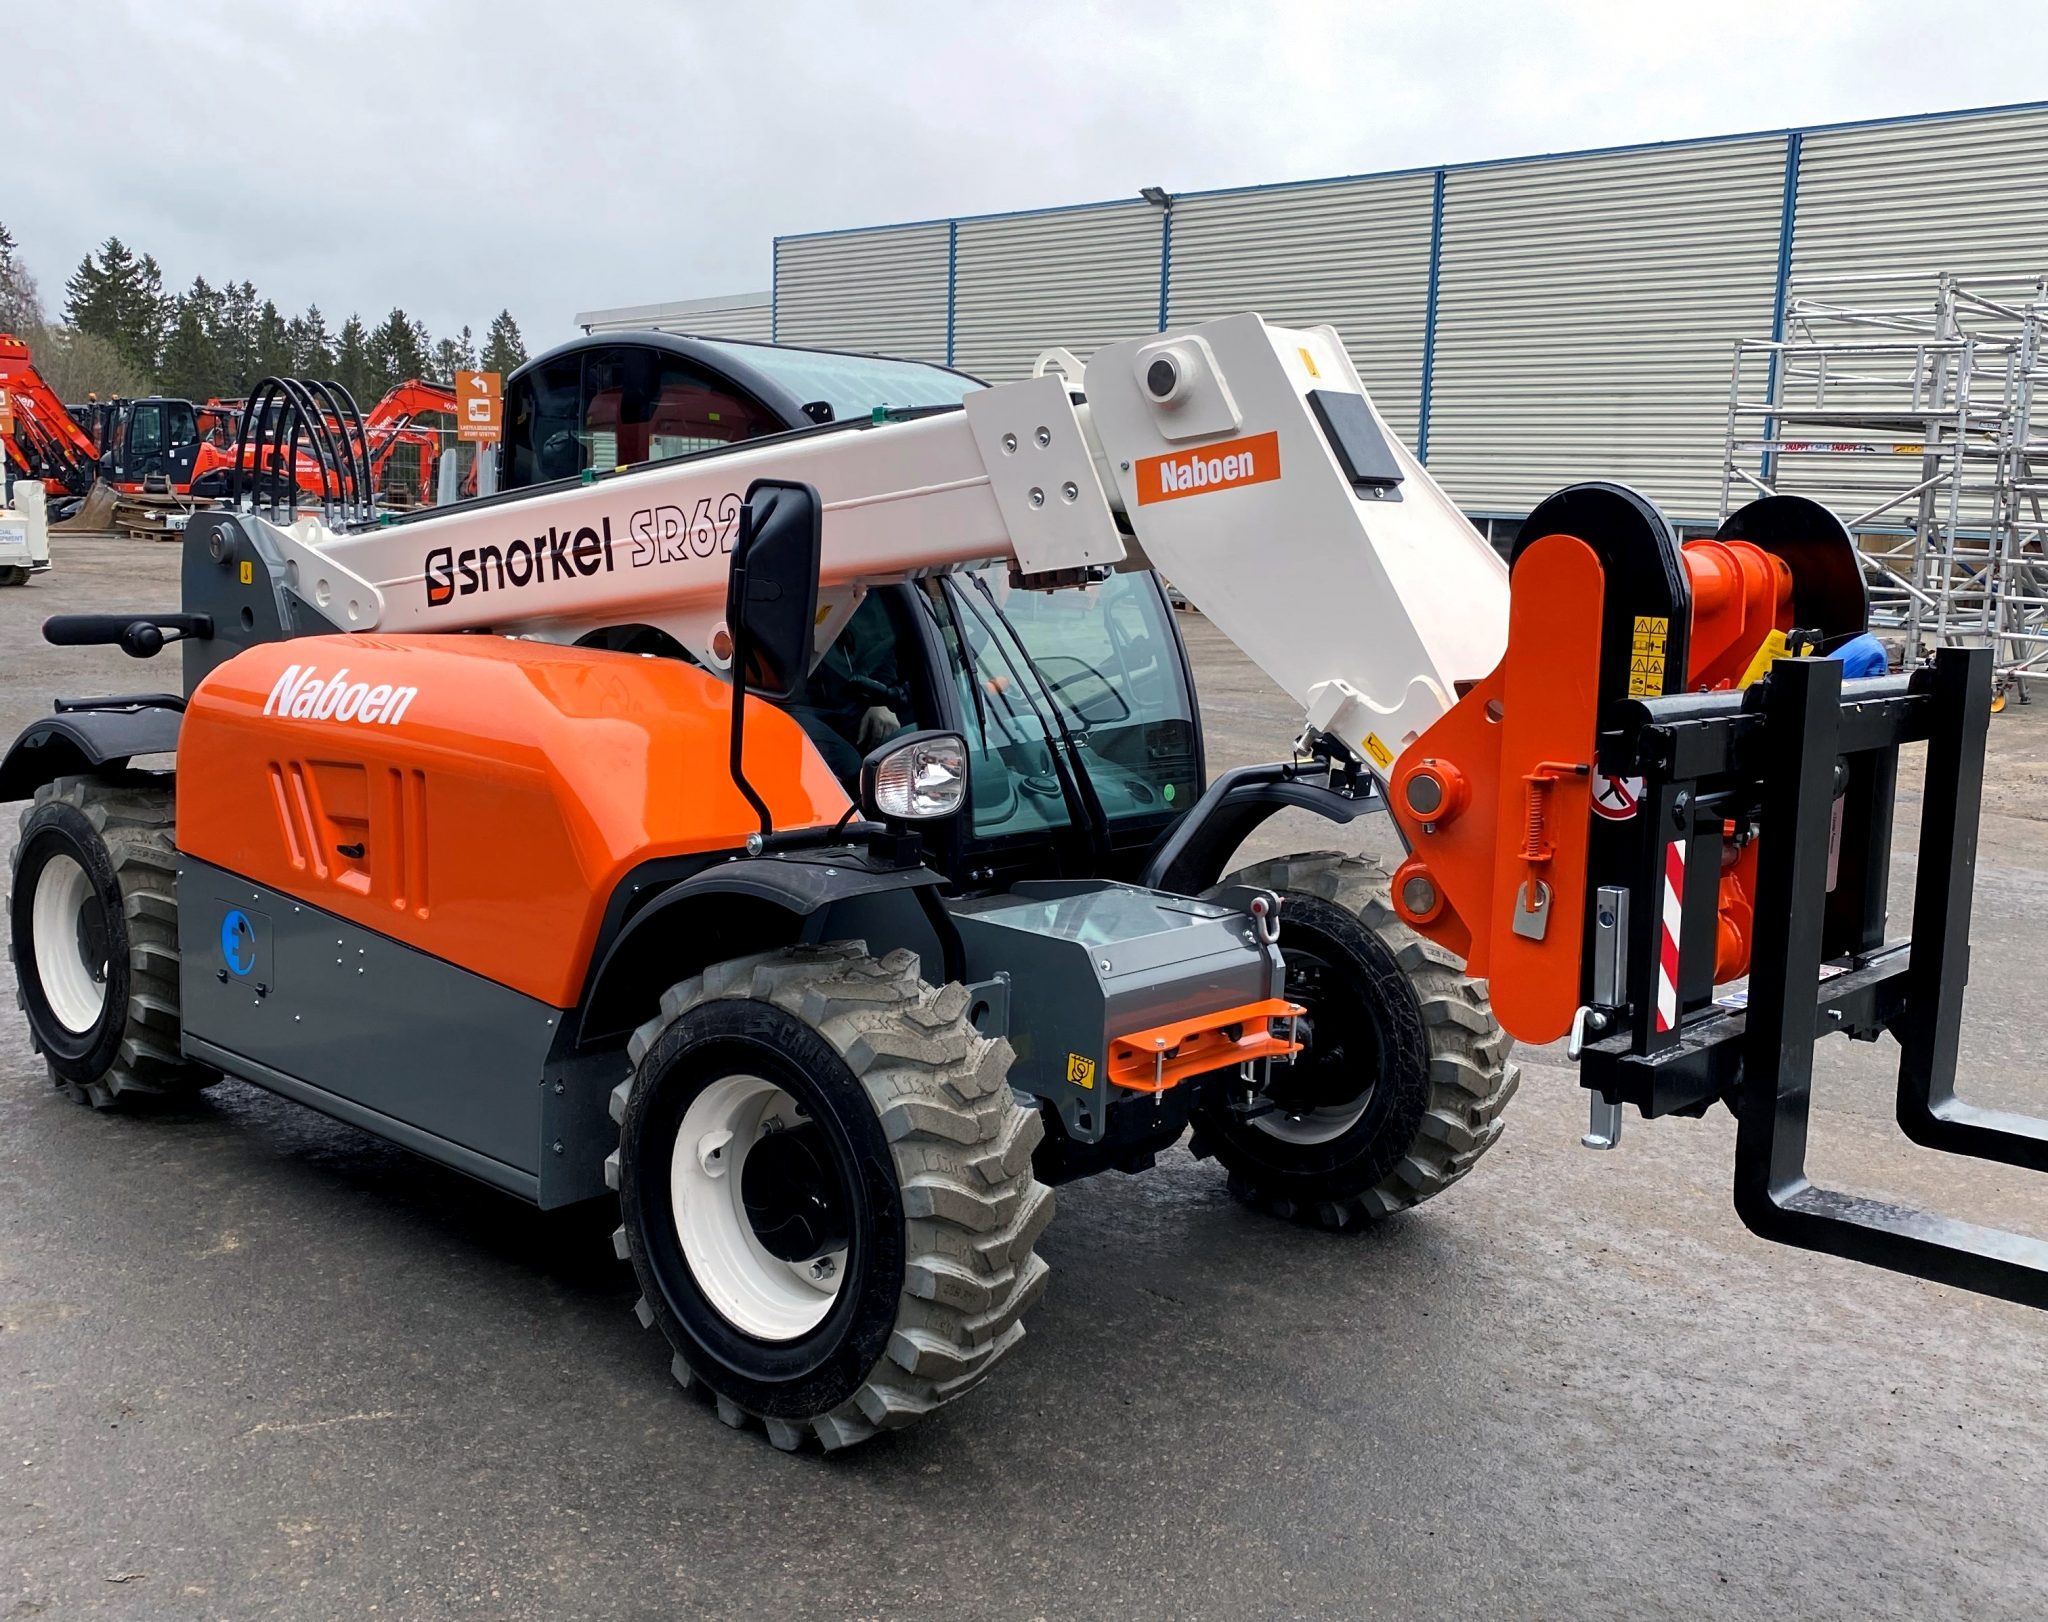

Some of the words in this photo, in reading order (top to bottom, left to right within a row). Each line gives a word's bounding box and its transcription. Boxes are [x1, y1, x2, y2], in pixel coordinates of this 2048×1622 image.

[1160, 450, 1254, 494] Naboen
[460, 516, 614, 596] snorkel
[262, 664, 418, 725] Naboen
